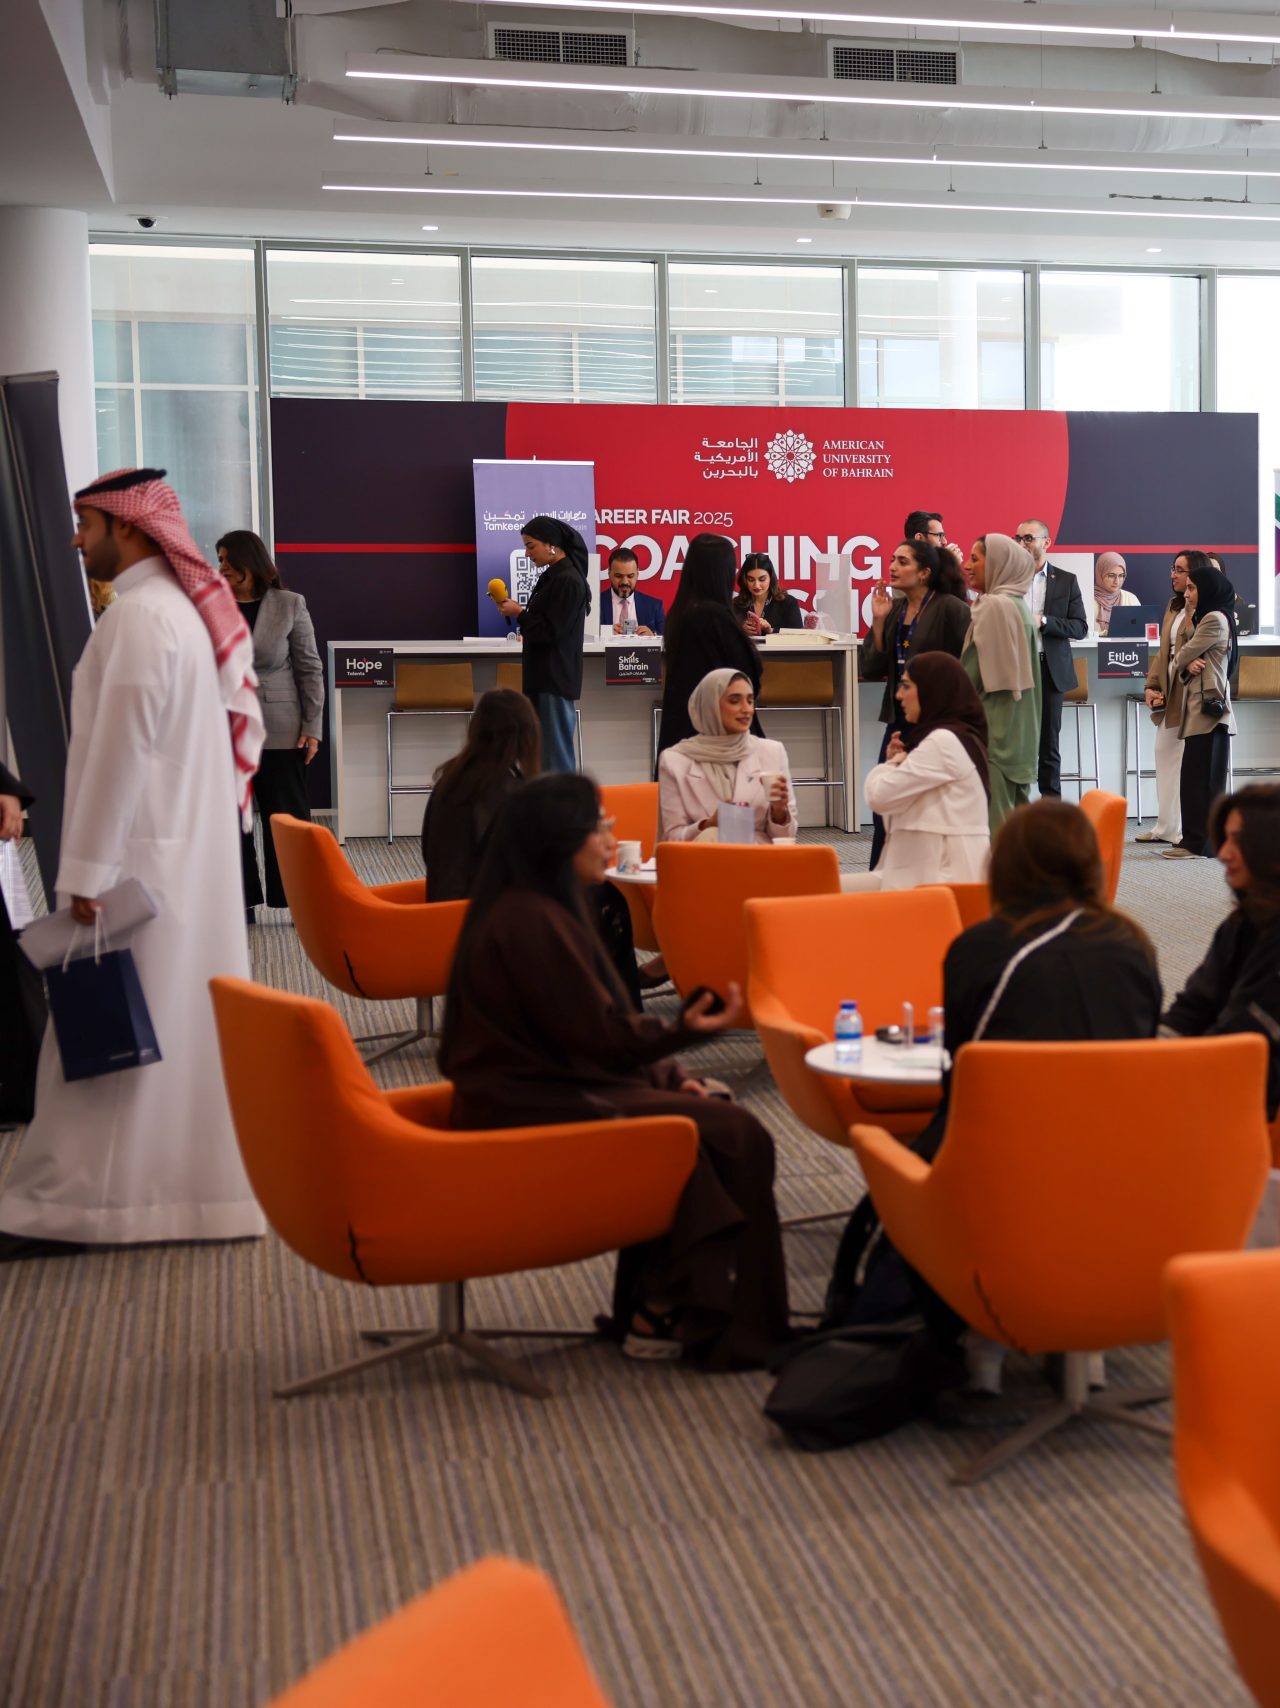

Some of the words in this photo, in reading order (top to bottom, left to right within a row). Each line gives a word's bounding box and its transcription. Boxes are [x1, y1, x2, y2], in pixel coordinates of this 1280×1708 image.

[702, 437, 758, 449] الجامعة
[823, 440, 884, 450] AMERICAN
[694, 450, 758, 465] الأمريكية
[823, 454, 891, 464] UNIVERSITY
[702, 466, 759, 479] بالبحرين
[823, 468, 838, 478] OF
[841, 468, 894, 478] BAHRAIN
[651, 509, 690, 524] FAIR
[694, 511, 734, 528] 2025
[619, 653, 639, 663] Skills
[346, 658, 383, 673] Hope
